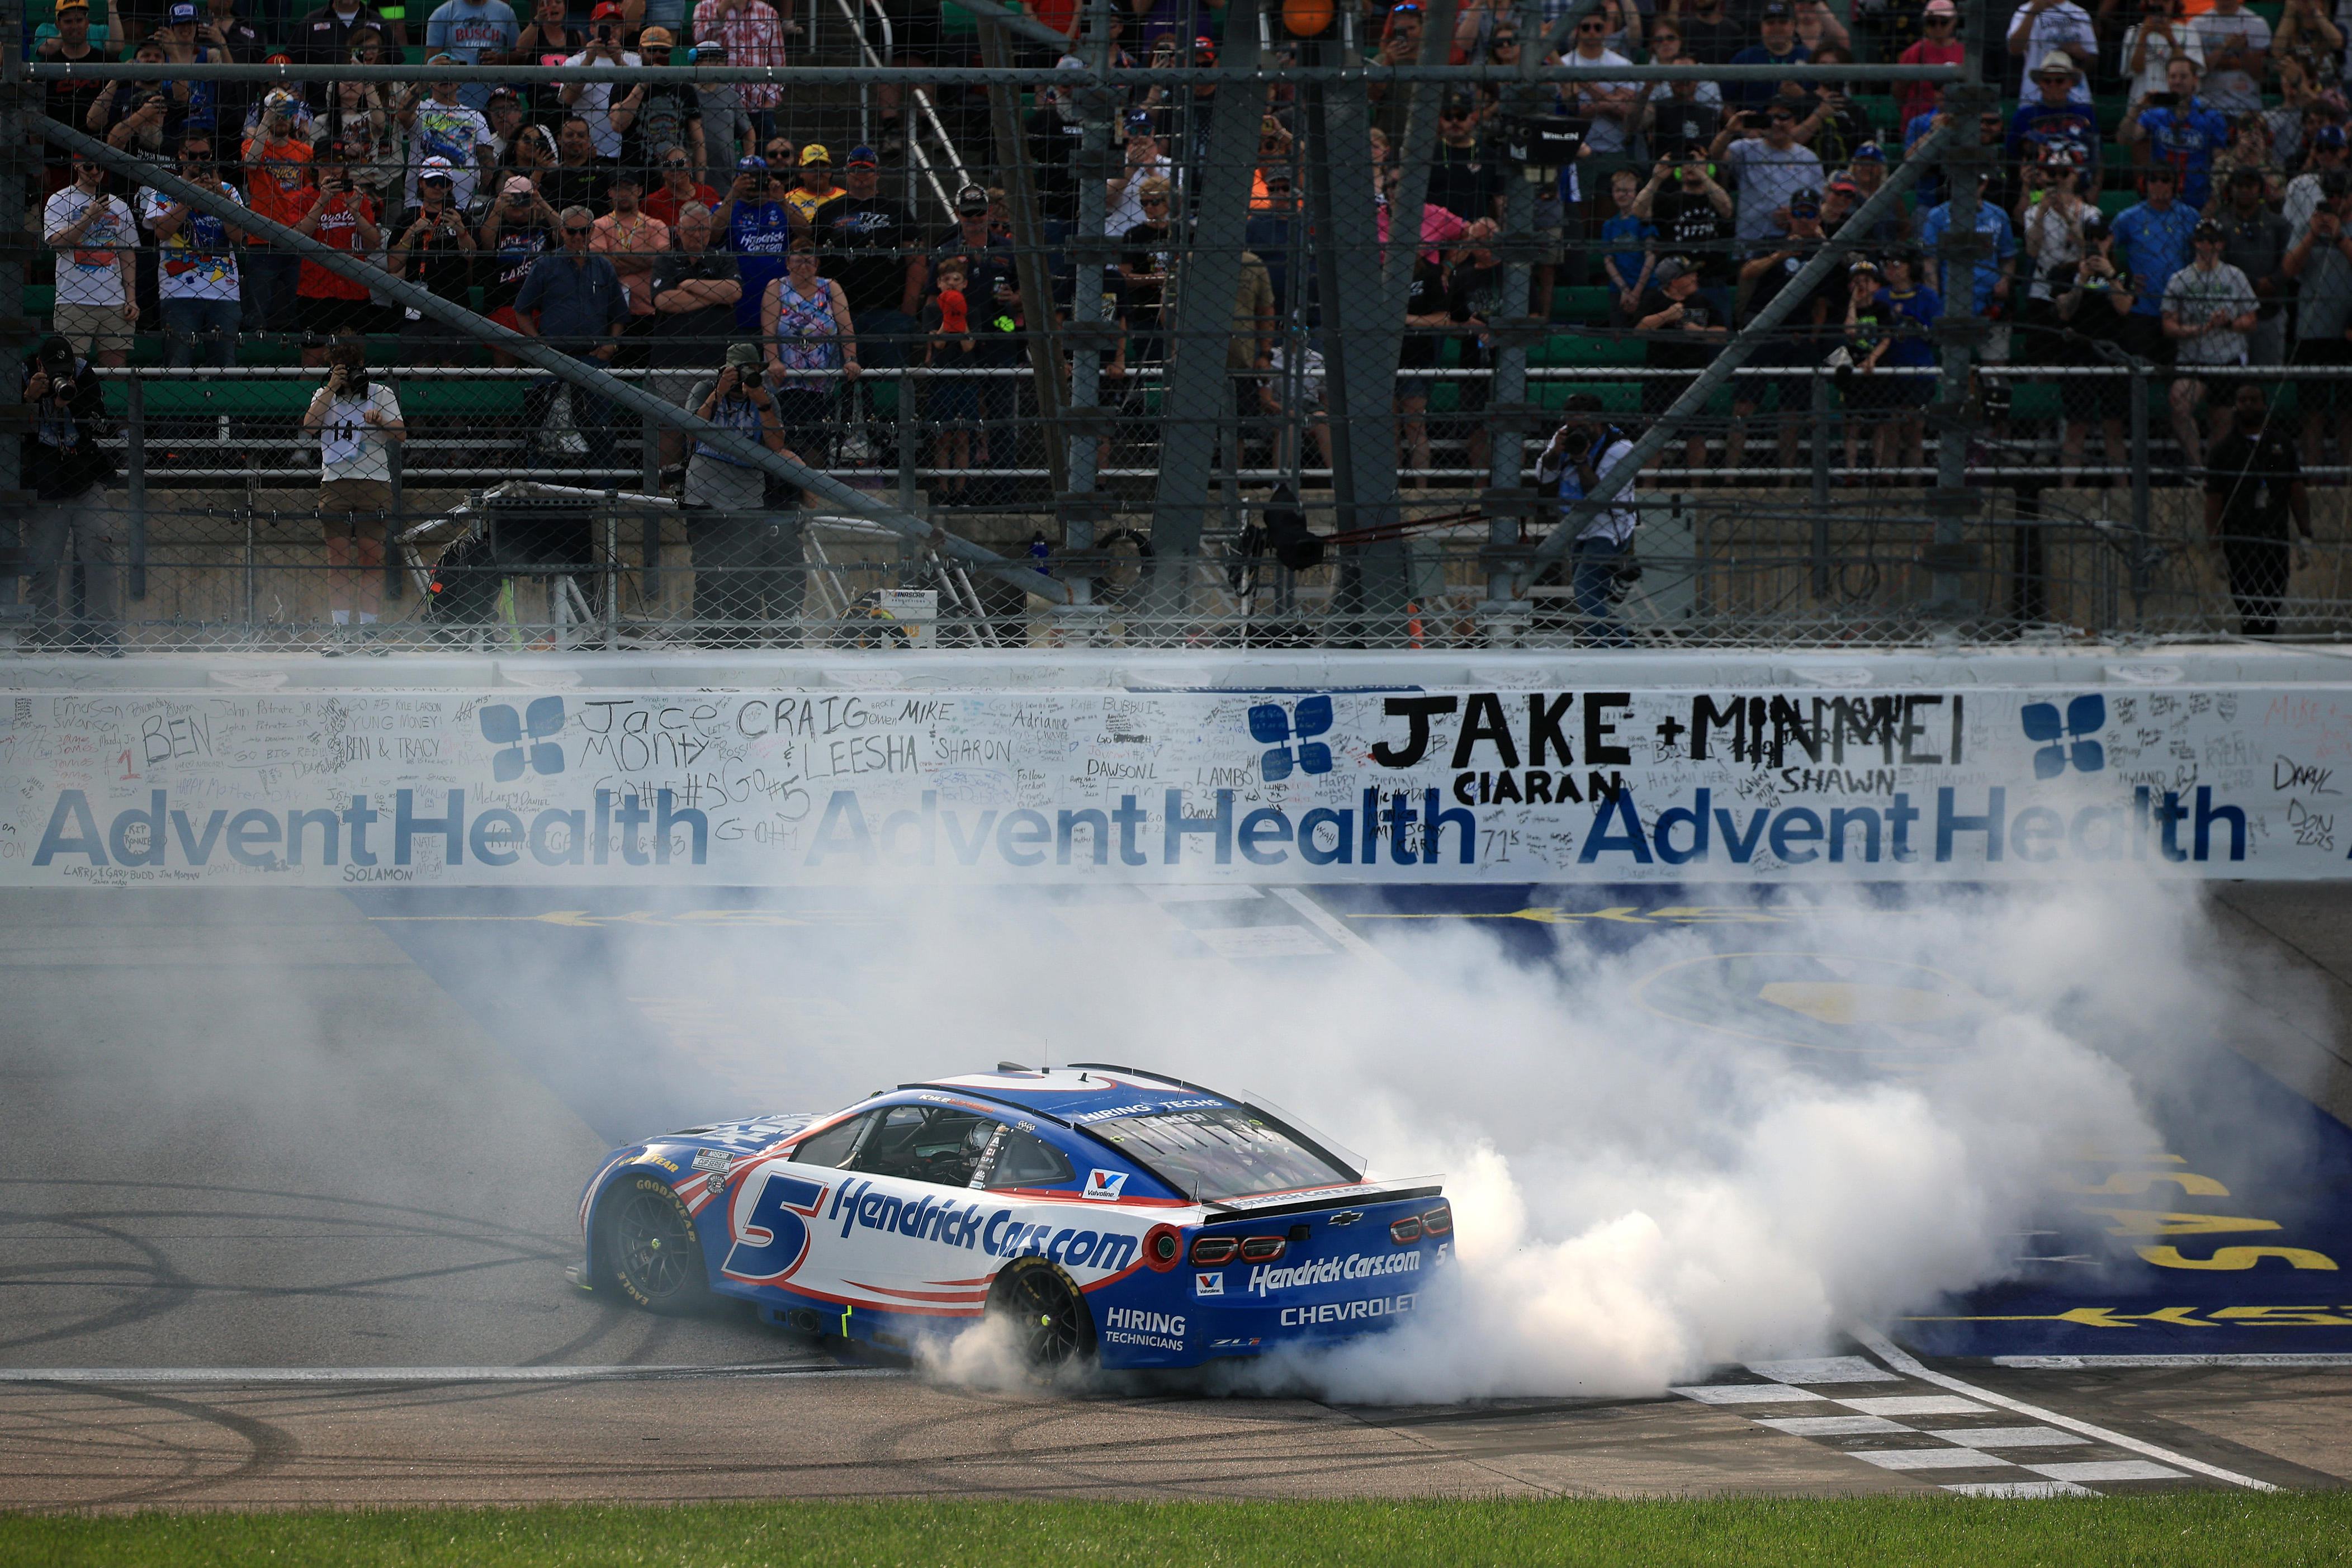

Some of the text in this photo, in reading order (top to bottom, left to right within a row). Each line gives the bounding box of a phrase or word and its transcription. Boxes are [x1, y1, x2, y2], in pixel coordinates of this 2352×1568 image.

[456, 29, 499, 42] BUSCH
[319, 209, 356, 224] oyota
[334, 420, 353, 441] 14
[209, 699, 249, 718] John
[373, 699, 390, 712] #5
[395, 699, 412, 712] KYLE
[415, 700, 442, 712] LARSON
[578, 699, 718, 738] Jace
[737, 695, 870, 743] CRAIG
[898, 699, 954, 724] MIKE
[142, 715, 213, 768] BEN
[1372, 693, 1631, 769] JAKE
[1655, 716, 1686, 746] +
[233, 750, 257, 762] GO
[266, 747, 291, 759] BIG
[346, 735, 371, 762] BEN
[378, 737, 391, 761] &
[393, 736, 441, 759] TRACY
[579, 731, 711, 772] Monty
[804, 734, 920, 781] LEESHA
[935, 737, 1011, 766] SHARON
[1196, 766, 1253, 787] LAMBO
[1453, 770, 1625, 807] CIARAN
[1778, 765, 1897, 797] SHAWN
[520, 791, 550, 806] DANIEL
[32, 788, 709, 866] AdventHealth
[804, 789, 1476, 866] AdventHealth
[1577, 785, 2246, 865] AdventHealth
[2288, 797, 2335, 832] DON
[130, 870, 154, 880] BUDD
[342, 863, 413, 883] SOLAMON
[1078, 1098, 1223, 1123] HIRING TECHS
[707, 1150, 730, 1160] NASCAR
[708, 1159, 726, 1169] SERIES
[1087, 1190, 1115, 1198] Valvoline
[636, 1179, 695, 1243] GOODYEAR
[721, 1169, 830, 1281] 5
[829, 1176, 1138, 1271] HendrickCars.com
[1435, 1244, 1449, 1267] 5
[1248, 1250, 1420, 1297] HendrickCars.com
[617, 1271, 650, 1307] EAGLE
[1106, 1307, 1186, 1336] HIRING
[1280, 1293, 1418, 1326] CHEVROLET
[1105, 1330, 1184, 1352] TECHNICIANS
